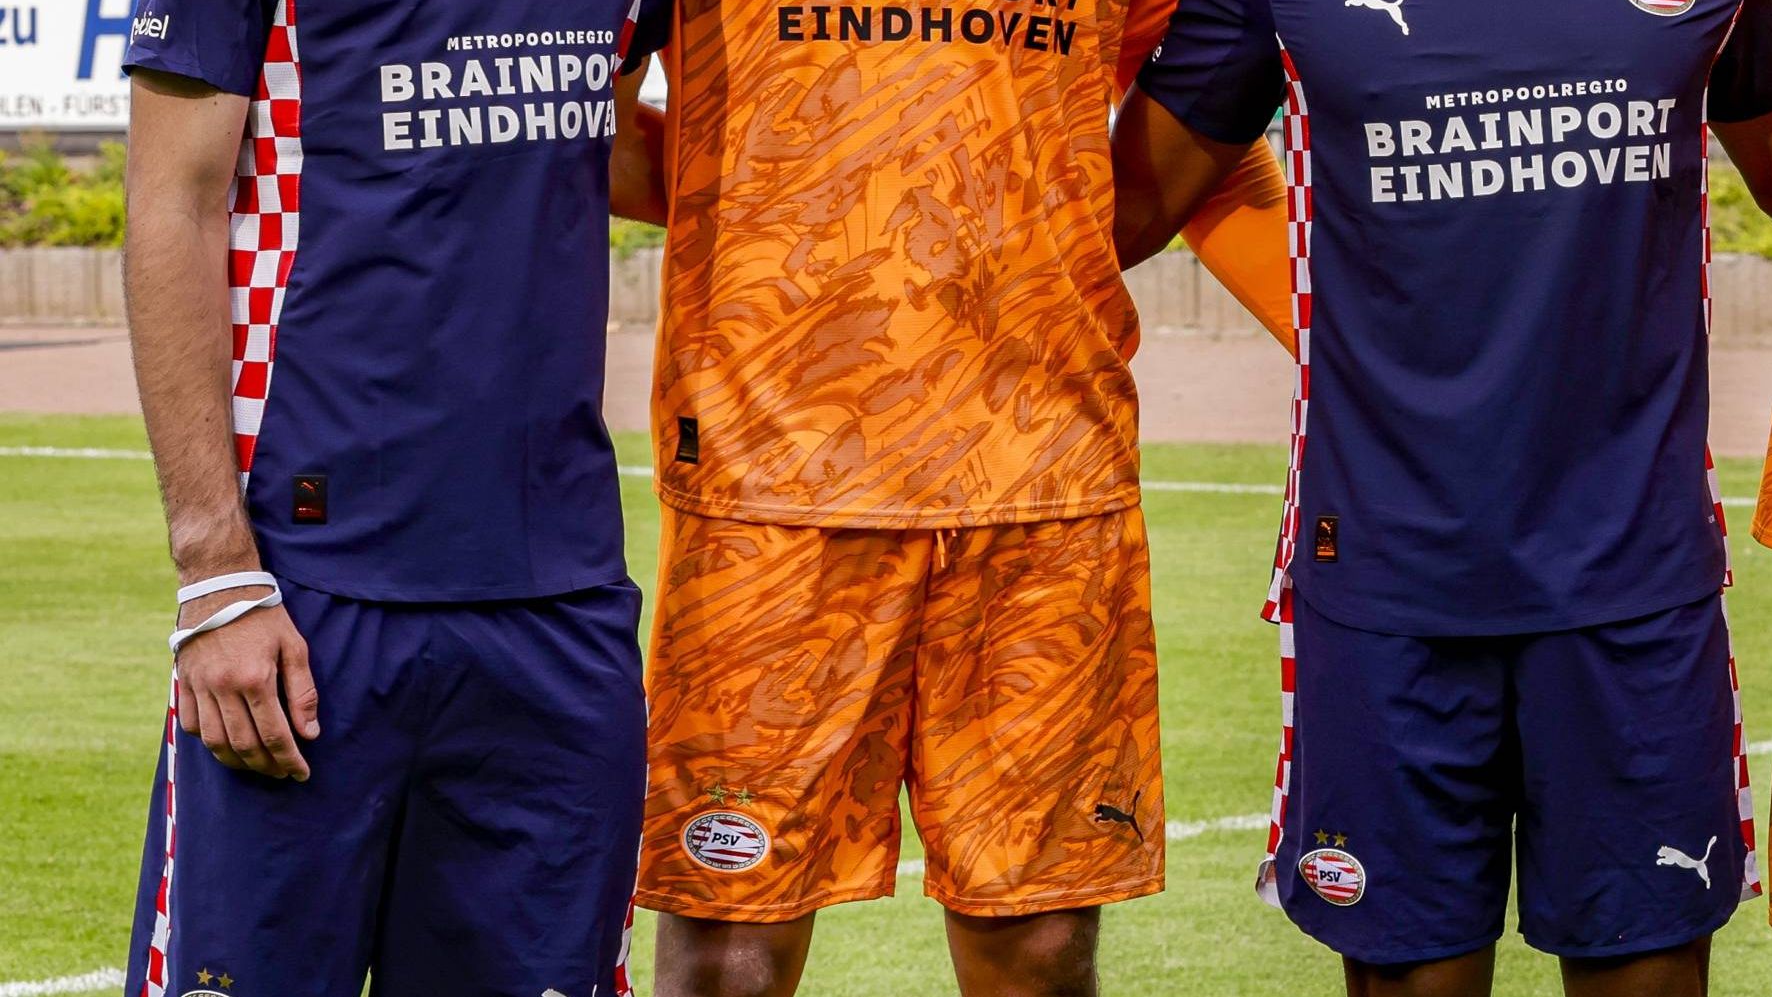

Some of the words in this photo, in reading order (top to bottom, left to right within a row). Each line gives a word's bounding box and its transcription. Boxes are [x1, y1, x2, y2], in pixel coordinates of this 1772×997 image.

[447, 30, 614, 51] METROPOOLREGIO
[778, 6, 1077, 56] EINDHOVEN
[380, 53, 617, 103] BRAINPO
[1426, 78, 1628, 109] METROPOOLREGIO
[1364, 98, 1677, 157] BRAINPORT
[1370, 142, 1671, 203] EINDHOVEN
[711, 832, 741, 846] PSV
[1319, 870, 1342, 883] PSV
